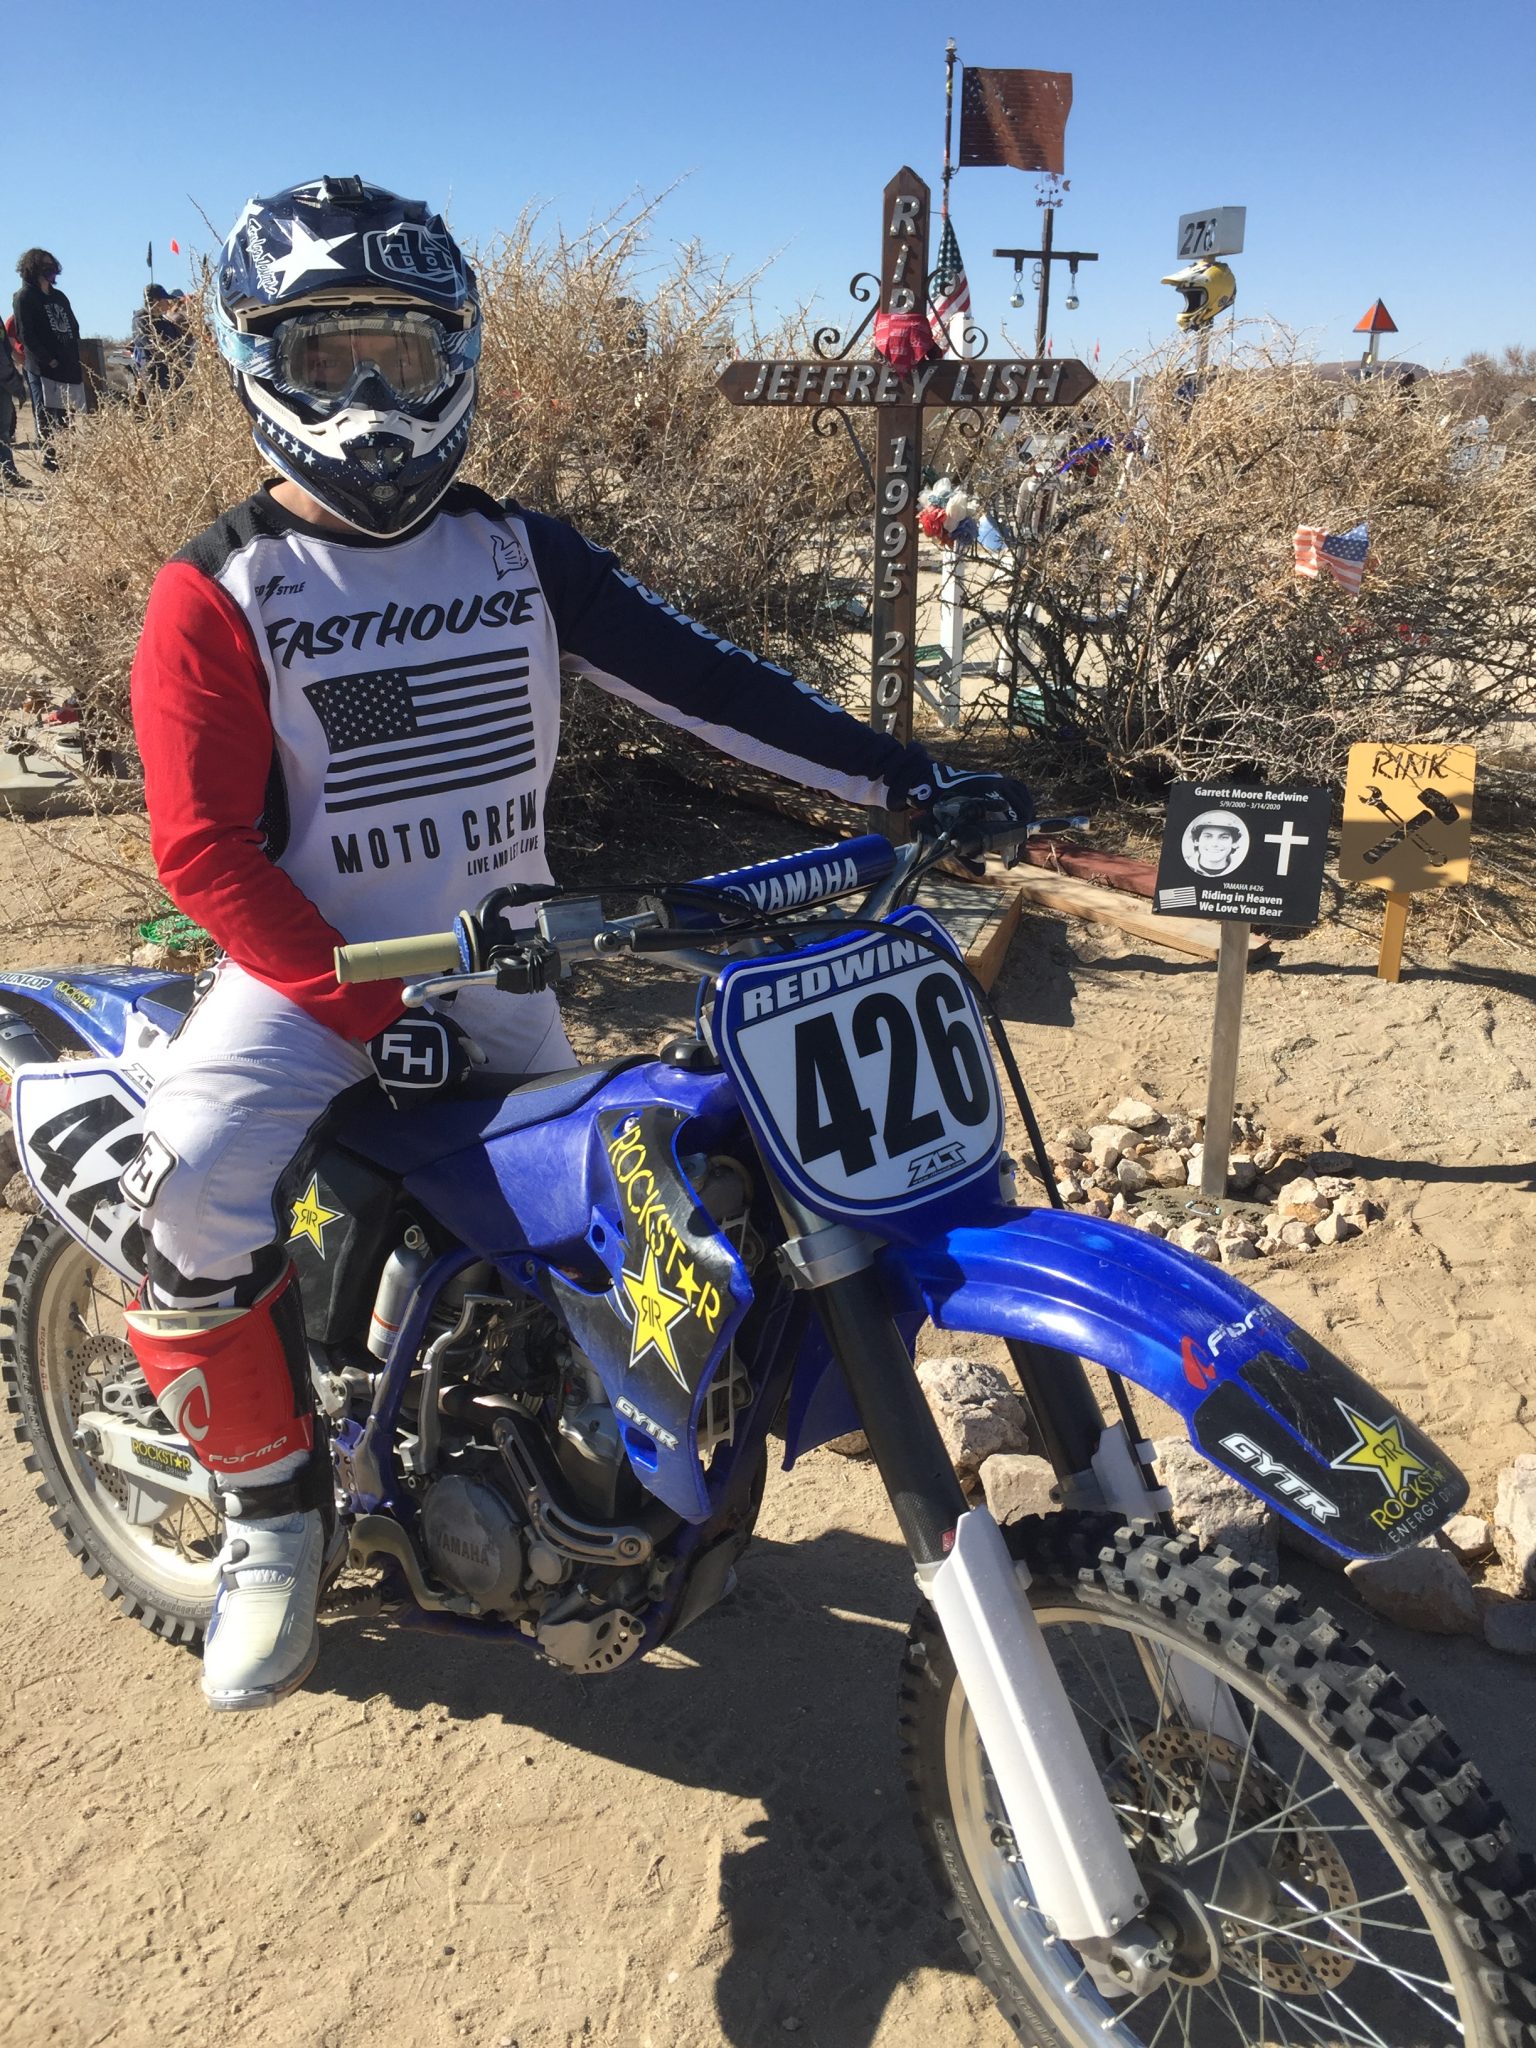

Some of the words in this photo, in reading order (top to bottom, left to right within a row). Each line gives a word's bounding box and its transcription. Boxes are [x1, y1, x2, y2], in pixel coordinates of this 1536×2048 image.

[744, 364, 938, 404] JEFFREY
[951, 364, 1065, 403] LISH
[880, 436, 909, 599] 1995
[265, 587, 541, 670] FASTHOUSE
[1194, 787, 1231, 799] Garrett
[1232, 789, 1263, 800] Moore
[1265, 791, 1309, 803] Redwine
[331, 817, 441, 874] MOTO
[461, 789, 538, 852] CREW
[467, 856, 490, 876] LIVE
[520, 835, 539, 854] LIVE
[748, 857, 858, 911] YAMAHA
[1201, 890, 1233, 902] Riding
[1234, 891, 1244, 902] in
[1246, 894, 1283, 905] Heaven
[1223, 882, 1249, 891] YAMAHA
[1199, 902, 1215, 911] We
[1216, 903, 1238, 913] Love
[1240, 904, 1257, 915] You
[1259, 907, 1283, 917] Bear
[794, 971, 990, 1178] 426
[615, 1396, 679, 1451] GYTR
[1218, 1432, 1340, 1524] GYTR
[1388, 1498, 1439, 1543] ENERGY
